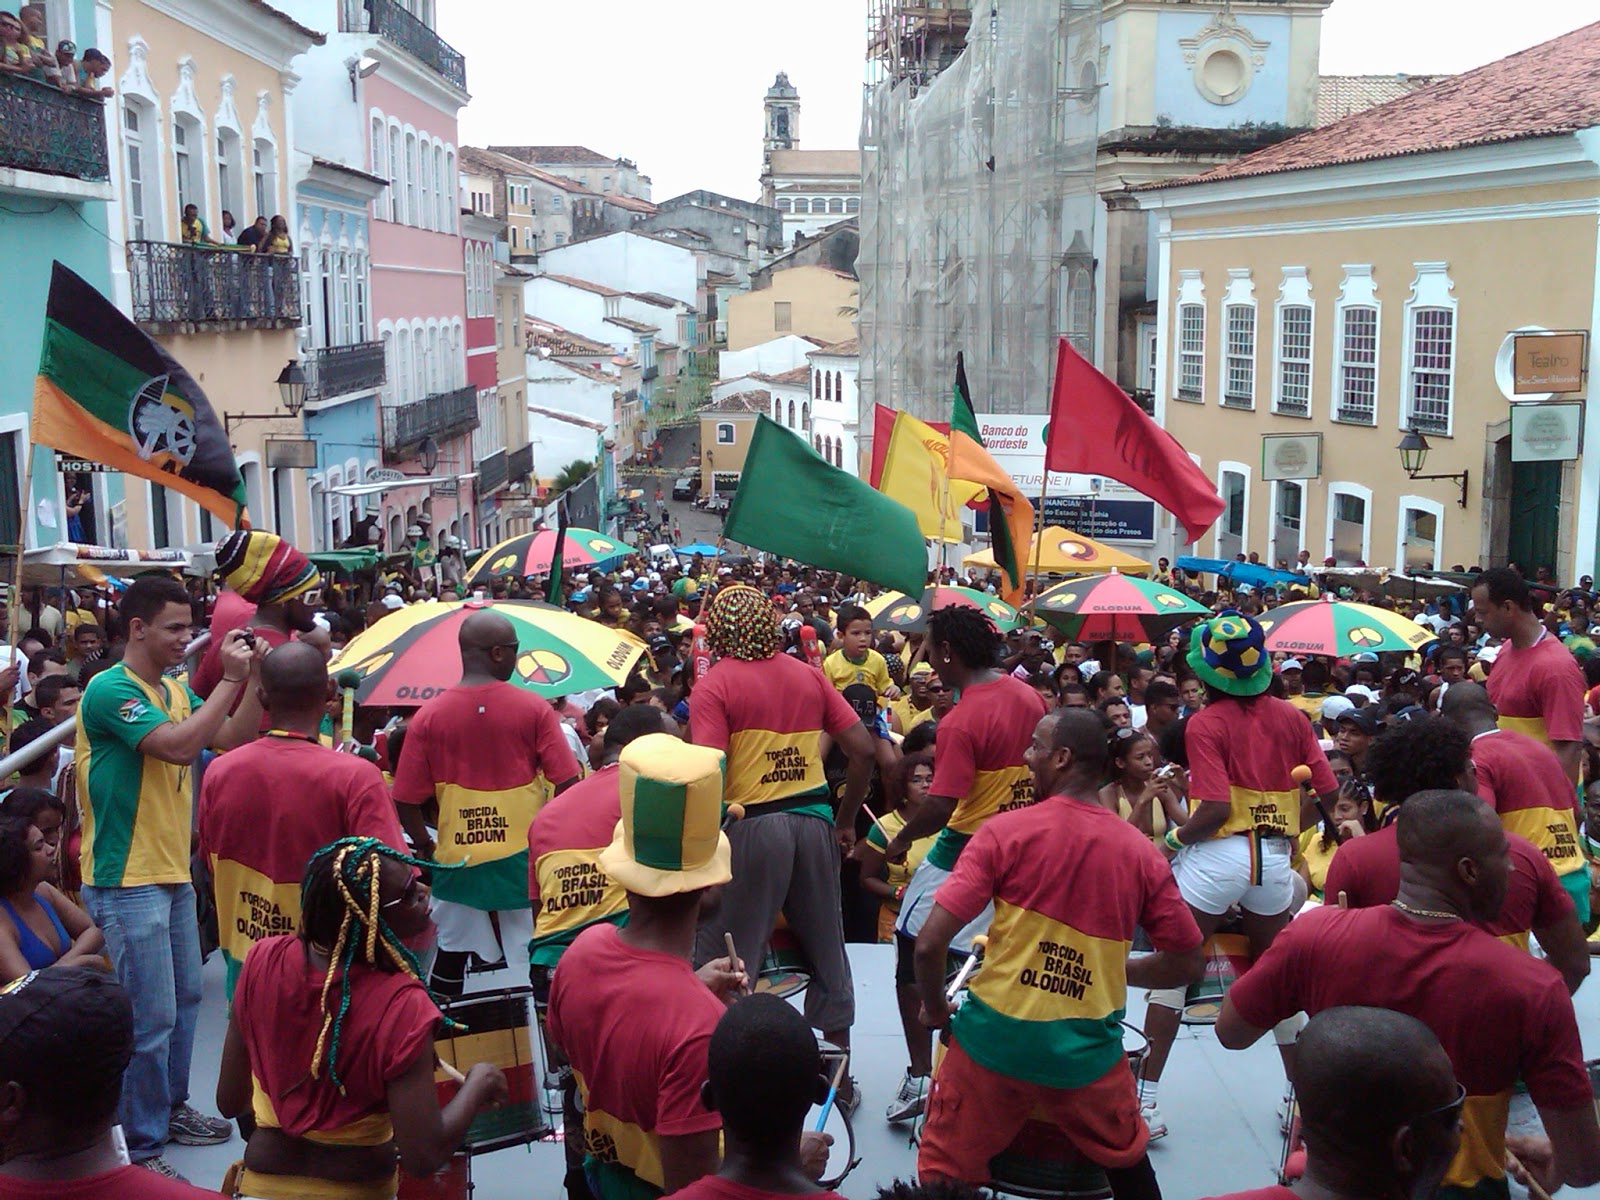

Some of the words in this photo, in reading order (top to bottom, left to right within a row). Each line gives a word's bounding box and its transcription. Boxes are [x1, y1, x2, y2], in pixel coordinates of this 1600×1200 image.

[1528, 352, 1569, 368] Teatro
[981, 425, 1013, 436] Banco
[1014, 425, 1029, 437] do
[982, 437, 1029, 450] Nordeste
[1055, 509, 1078, 517] Estado
[1276, 641, 1324, 650] OLODUM
[459, 806, 498, 819] TORCIDA
[467, 817, 509, 830] BRASIL
[455, 829, 506, 845] OLODUM
[554, 863, 598, 879] TORCIDA
[561, 873, 609, 893] BRASIL
[240, 891, 281, 916] TORCIDA
[546, 889, 604, 914] OLODUM
[251, 907, 295, 931] BRASIL
[1038, 941, 1085, 966] TORCIDA
[1044, 956, 1093, 986] BRASIL
[1020, 969, 1086, 1000] OLODUM
